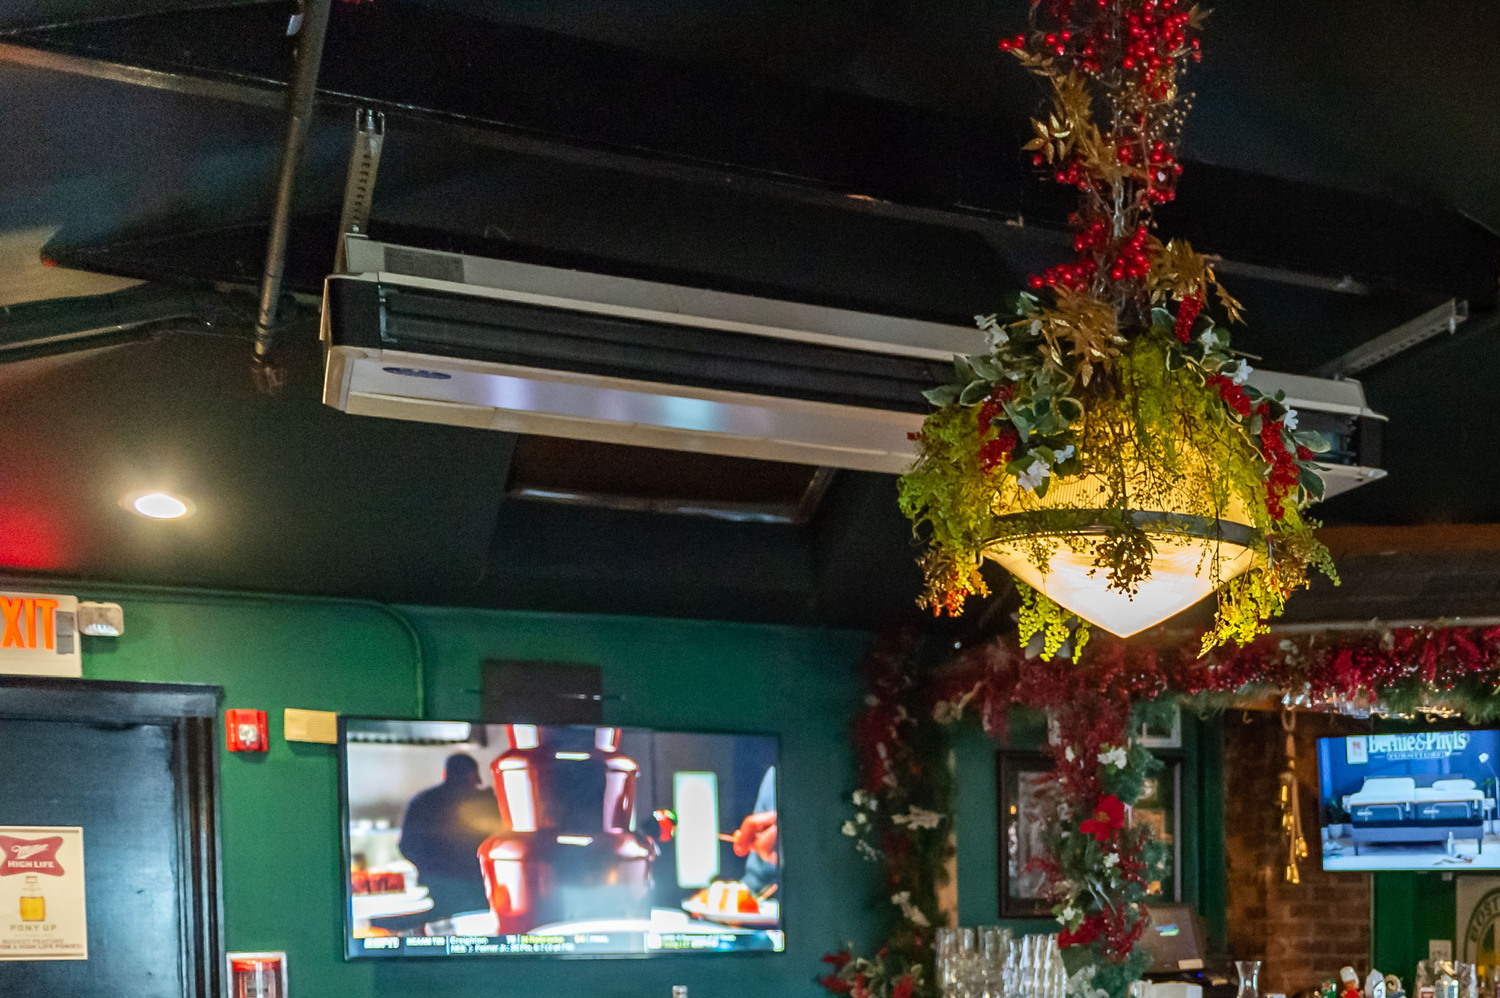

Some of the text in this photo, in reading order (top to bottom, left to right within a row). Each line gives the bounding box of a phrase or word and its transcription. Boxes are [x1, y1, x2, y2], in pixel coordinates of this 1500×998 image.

[0, 596, 58, 650] XIT
[8, 860, 55, 869] HIGH LIFE
[10, 924, 57, 932] PONY UP
